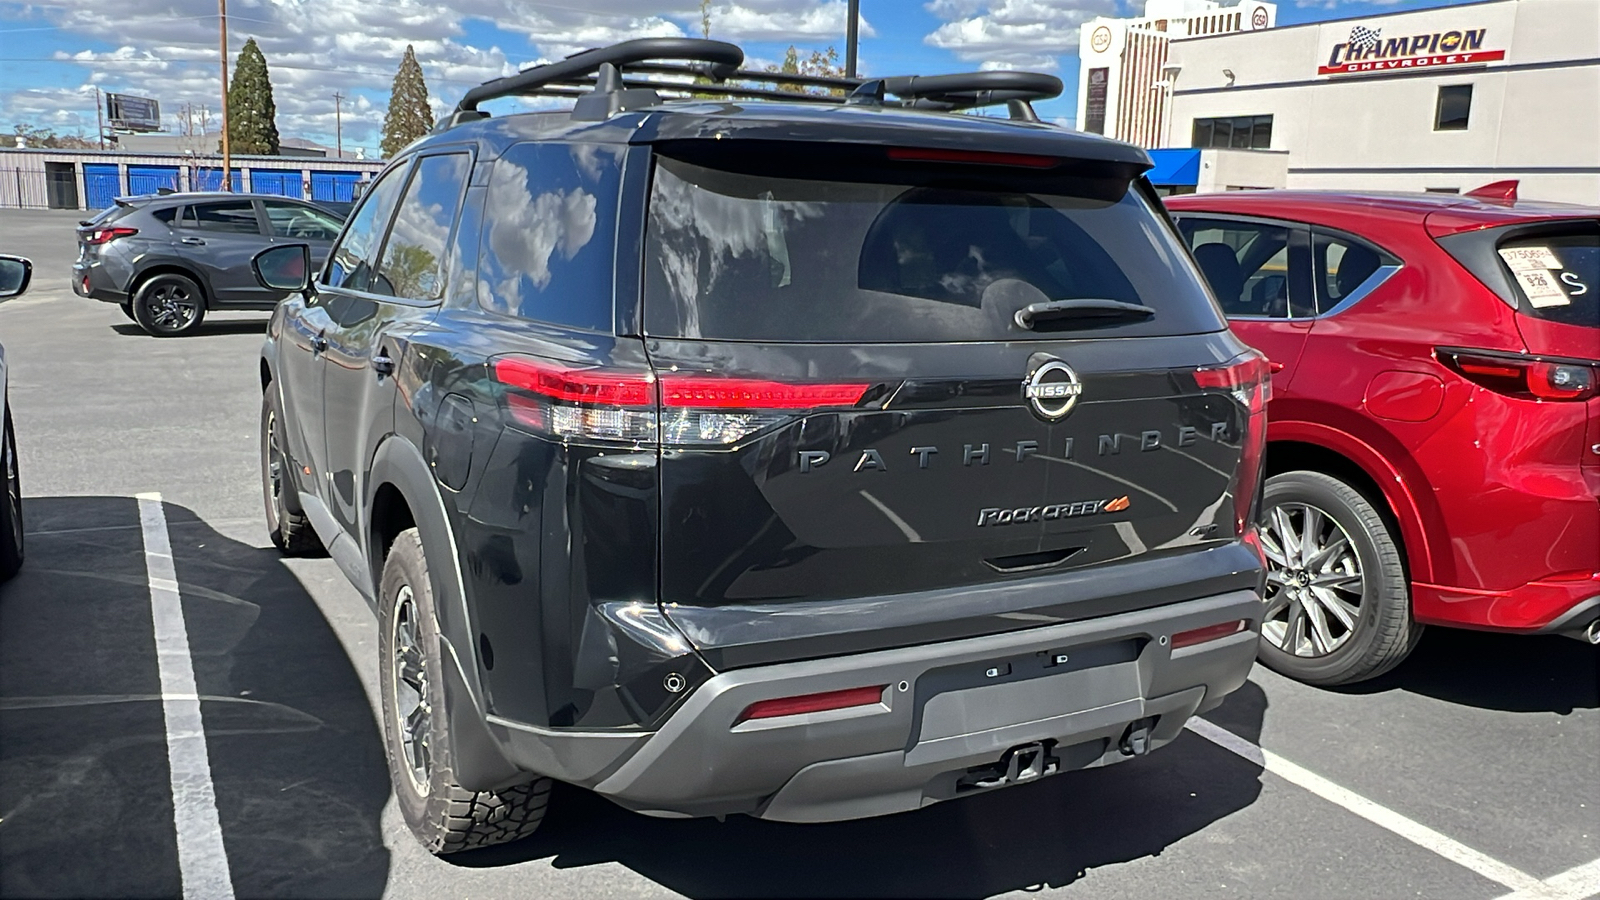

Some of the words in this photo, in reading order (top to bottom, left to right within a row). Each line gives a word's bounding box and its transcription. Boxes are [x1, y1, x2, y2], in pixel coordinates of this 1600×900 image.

[1327, 28, 1487, 68] CHAMPION
[1347, 54, 1472, 72] CHEVROLET
[1560, 272, 1588, 295] S
[1027, 384, 1082, 397] NISSAN
[799, 421, 1229, 474] PATHFINDER
[977, 506, 1041, 527] ROCK
[1041, 499, 1108, 520] CREEK
